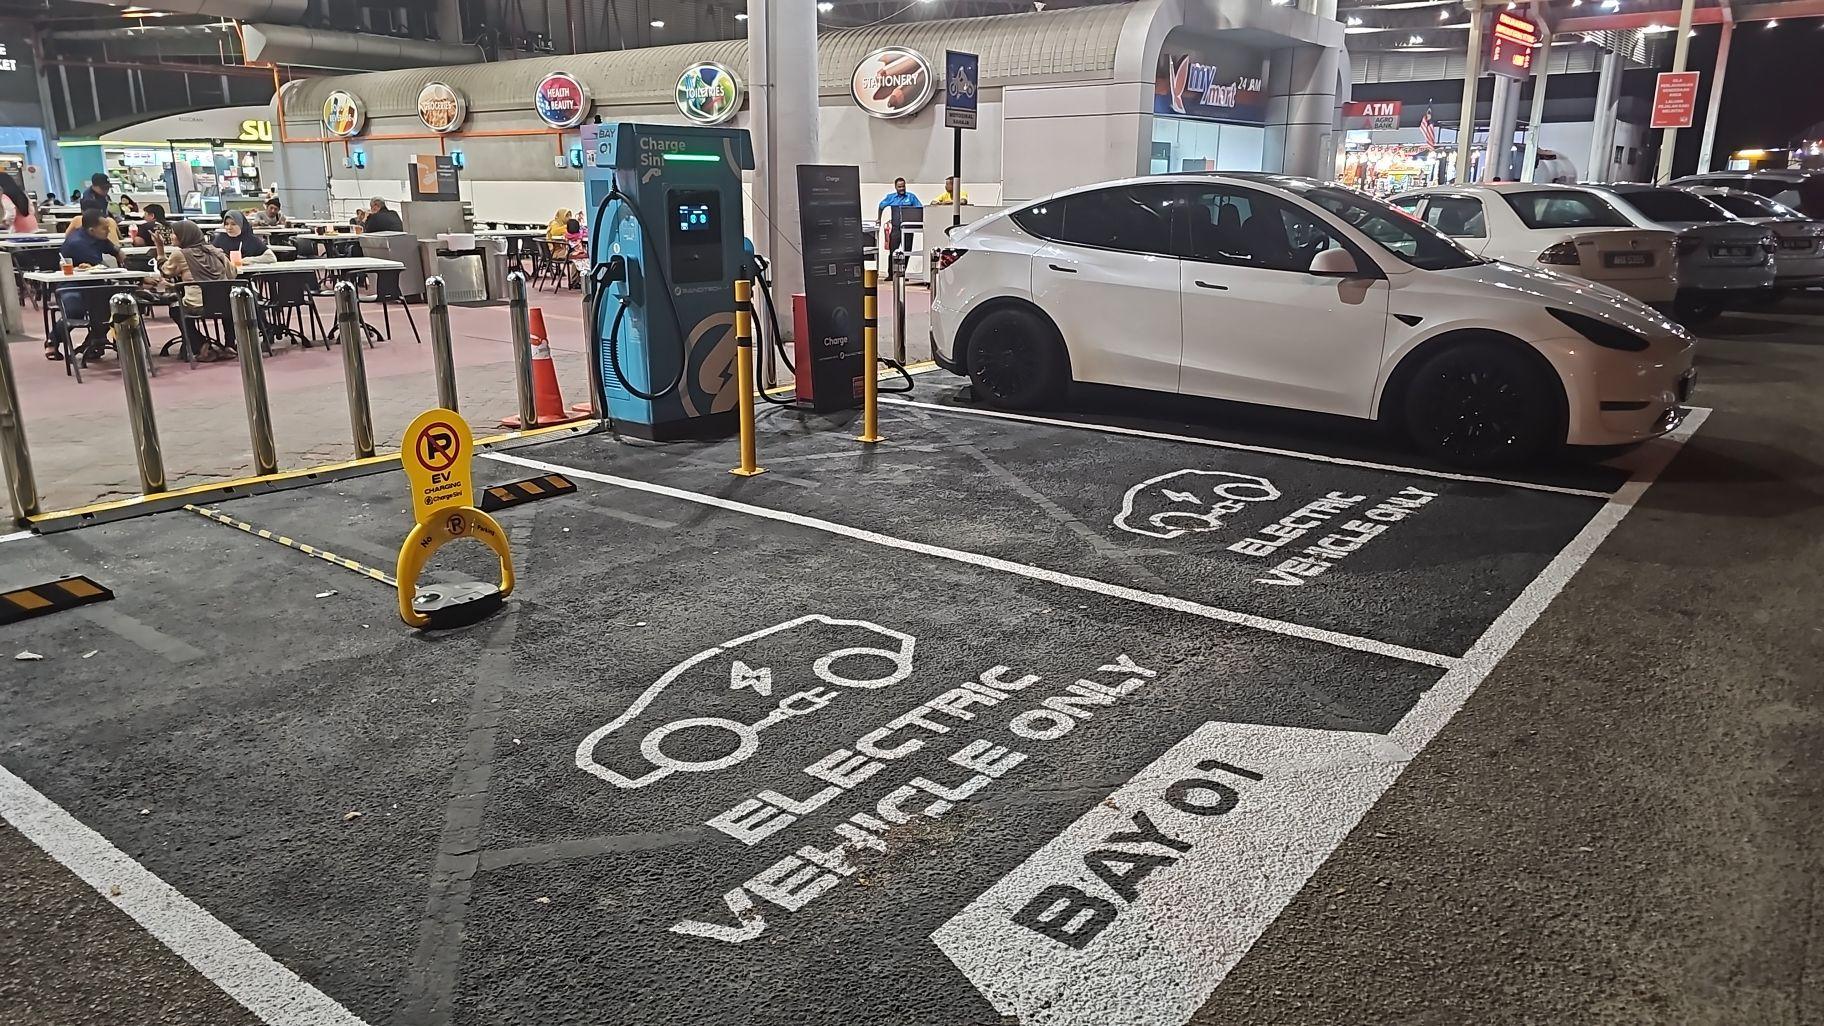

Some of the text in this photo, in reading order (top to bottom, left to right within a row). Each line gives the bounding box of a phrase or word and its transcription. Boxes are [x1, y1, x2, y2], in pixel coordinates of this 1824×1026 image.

[862, 74, 919, 90] STATIONERY
[1237, 77, 1247, 90] 24
[547, 88, 570, 98] HEALTH
[685, 87, 725, 99] TOILETRIES
[551, 100, 574, 111] BEAUTY
[1362, 103, 1395, 116] ATM
[598, 128, 616, 139] BAY
[640, 137, 686, 154] Charge
[640, 153, 665, 166] Sini
[823, 336, 848, 346] Charge
[431, 470, 451, 485] EV
[424, 481, 462, 495] CHARGING
[1226, 490, 1367, 557] ELECTRIC
[420, 536, 433, 549] No
[477, 524, 496, 537] Parking
[1251, 486, 1438, 586] VEHICLE ONLY
[705, 664, 1042, 846] ELECTRIC
[669, 653, 1157, 944] VEHICLE ONLY
[1010, 810, 1194, 951] BAY
